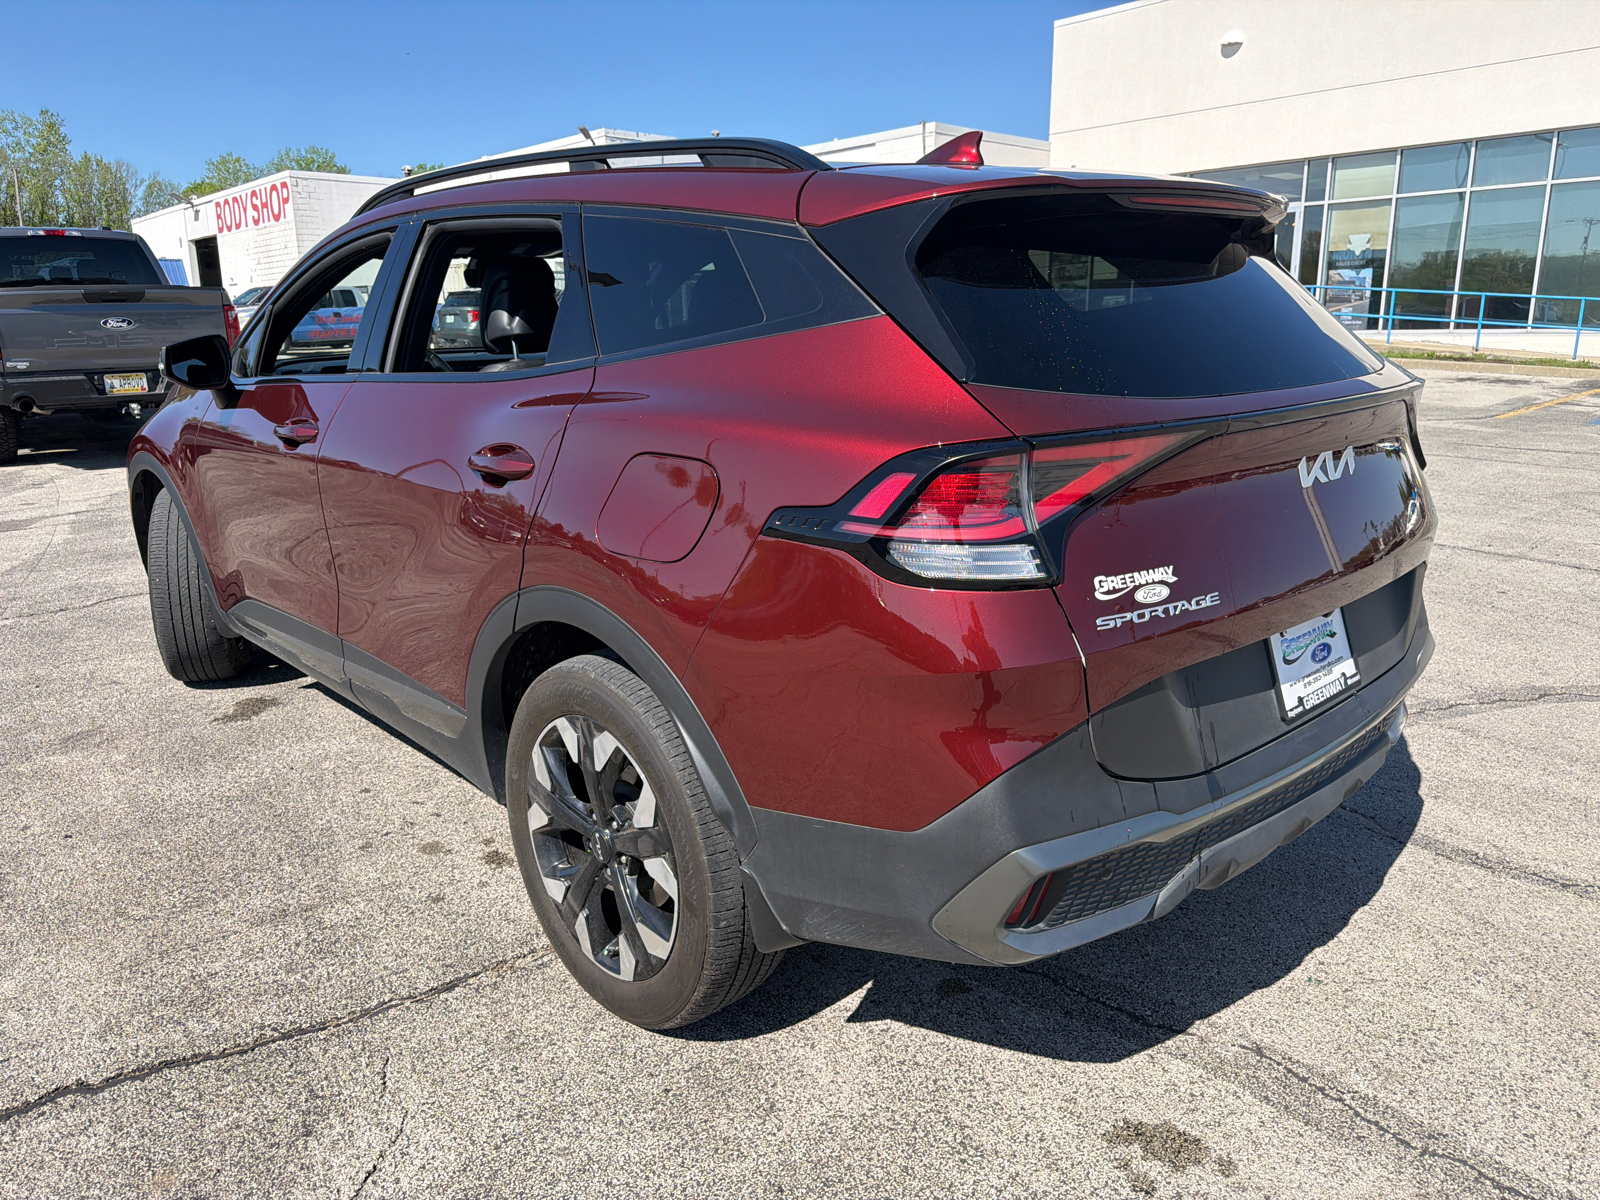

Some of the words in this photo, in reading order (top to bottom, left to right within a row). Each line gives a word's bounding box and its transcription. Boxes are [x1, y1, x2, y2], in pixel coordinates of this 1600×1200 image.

[215, 192, 248, 234] BODY
[250, 181, 290, 226] SHOP
[339, 314, 363, 324] Smit
[119, 377, 145, 389] APROVD
[1095, 592, 1221, 631] SPORTAGE
[1303, 676, 1346, 710] GREENWAY
